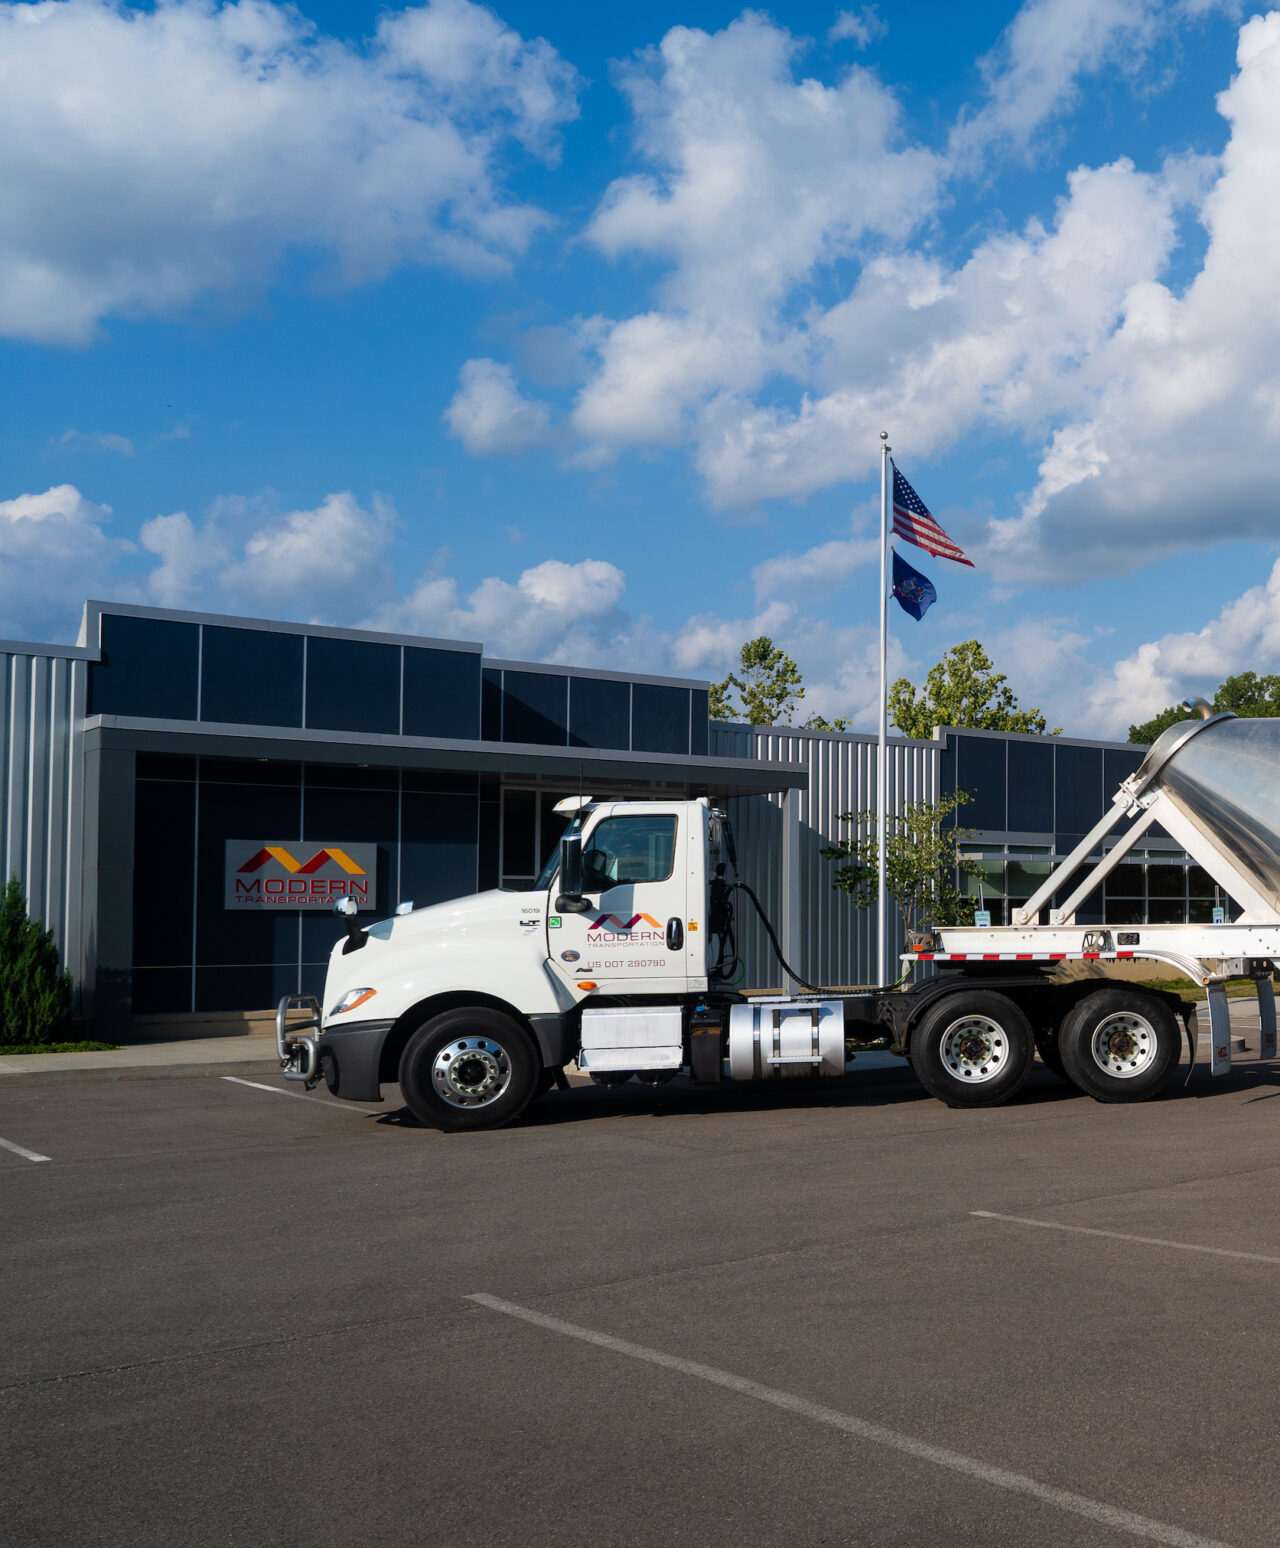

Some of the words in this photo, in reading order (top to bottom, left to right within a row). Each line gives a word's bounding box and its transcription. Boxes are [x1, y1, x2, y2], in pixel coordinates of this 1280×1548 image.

[235, 879, 368, 894] MODERN
[235, 895, 367, 904] TRANSPORTAN
[587, 931, 665, 942] MODERN
[588, 941, 665, 949] TRANSPORTATION
[604, 960, 625, 968] DOT
[627, 959, 666, 968] 290790
